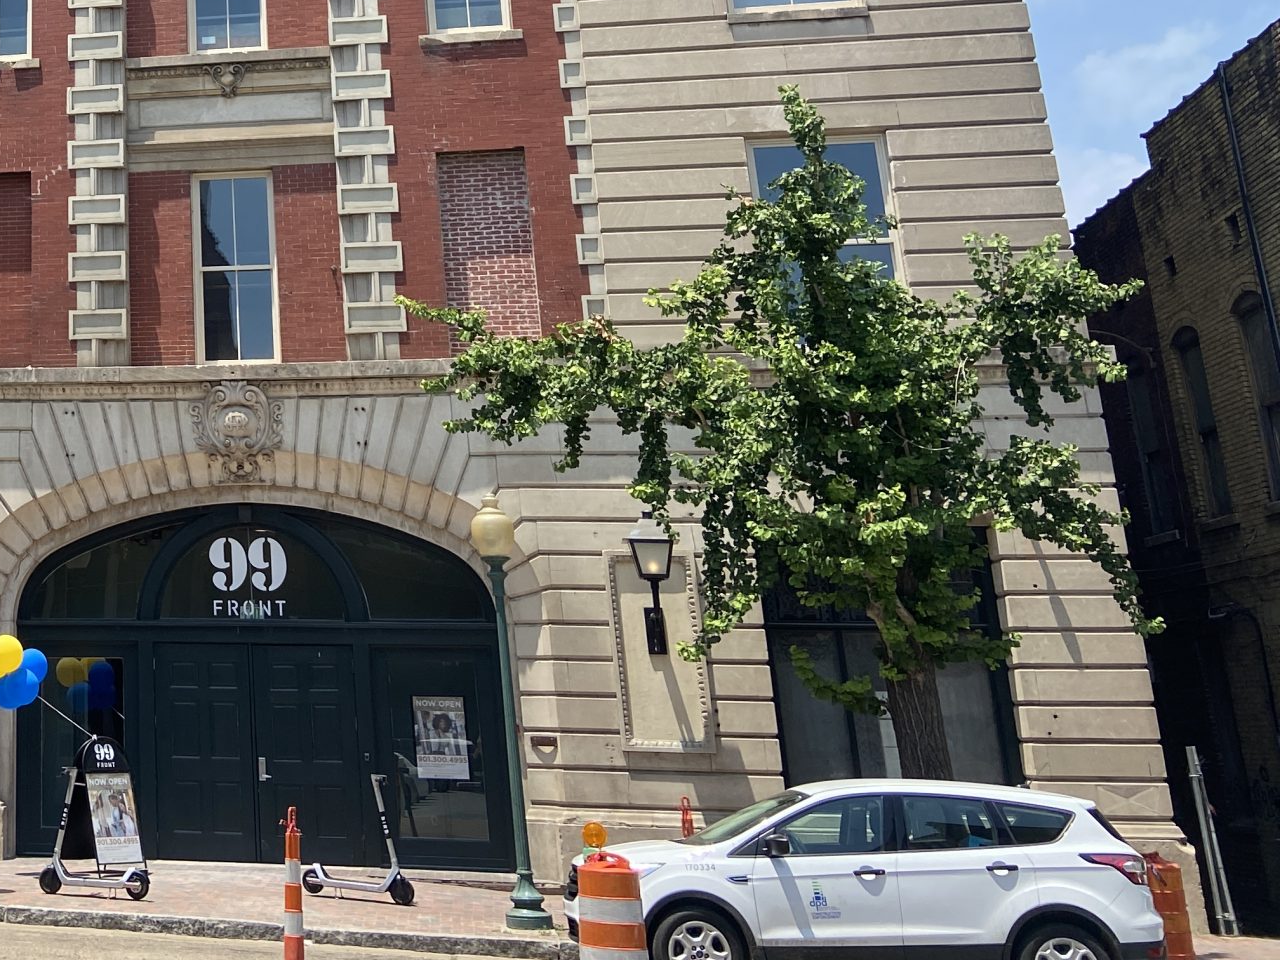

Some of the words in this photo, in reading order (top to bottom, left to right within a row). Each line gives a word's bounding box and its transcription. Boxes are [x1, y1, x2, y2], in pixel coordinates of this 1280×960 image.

[208, 537, 288, 592] 99
[213, 599, 286, 617] FRONT
[439, 700, 461, 708] OPEN
[94, 743, 115, 760] 99
[88, 778, 109, 786] NOW
[109, 777, 128, 786] OPEN
[685, 863, 716, 871] 170334
[810, 896, 828, 911] dpd
